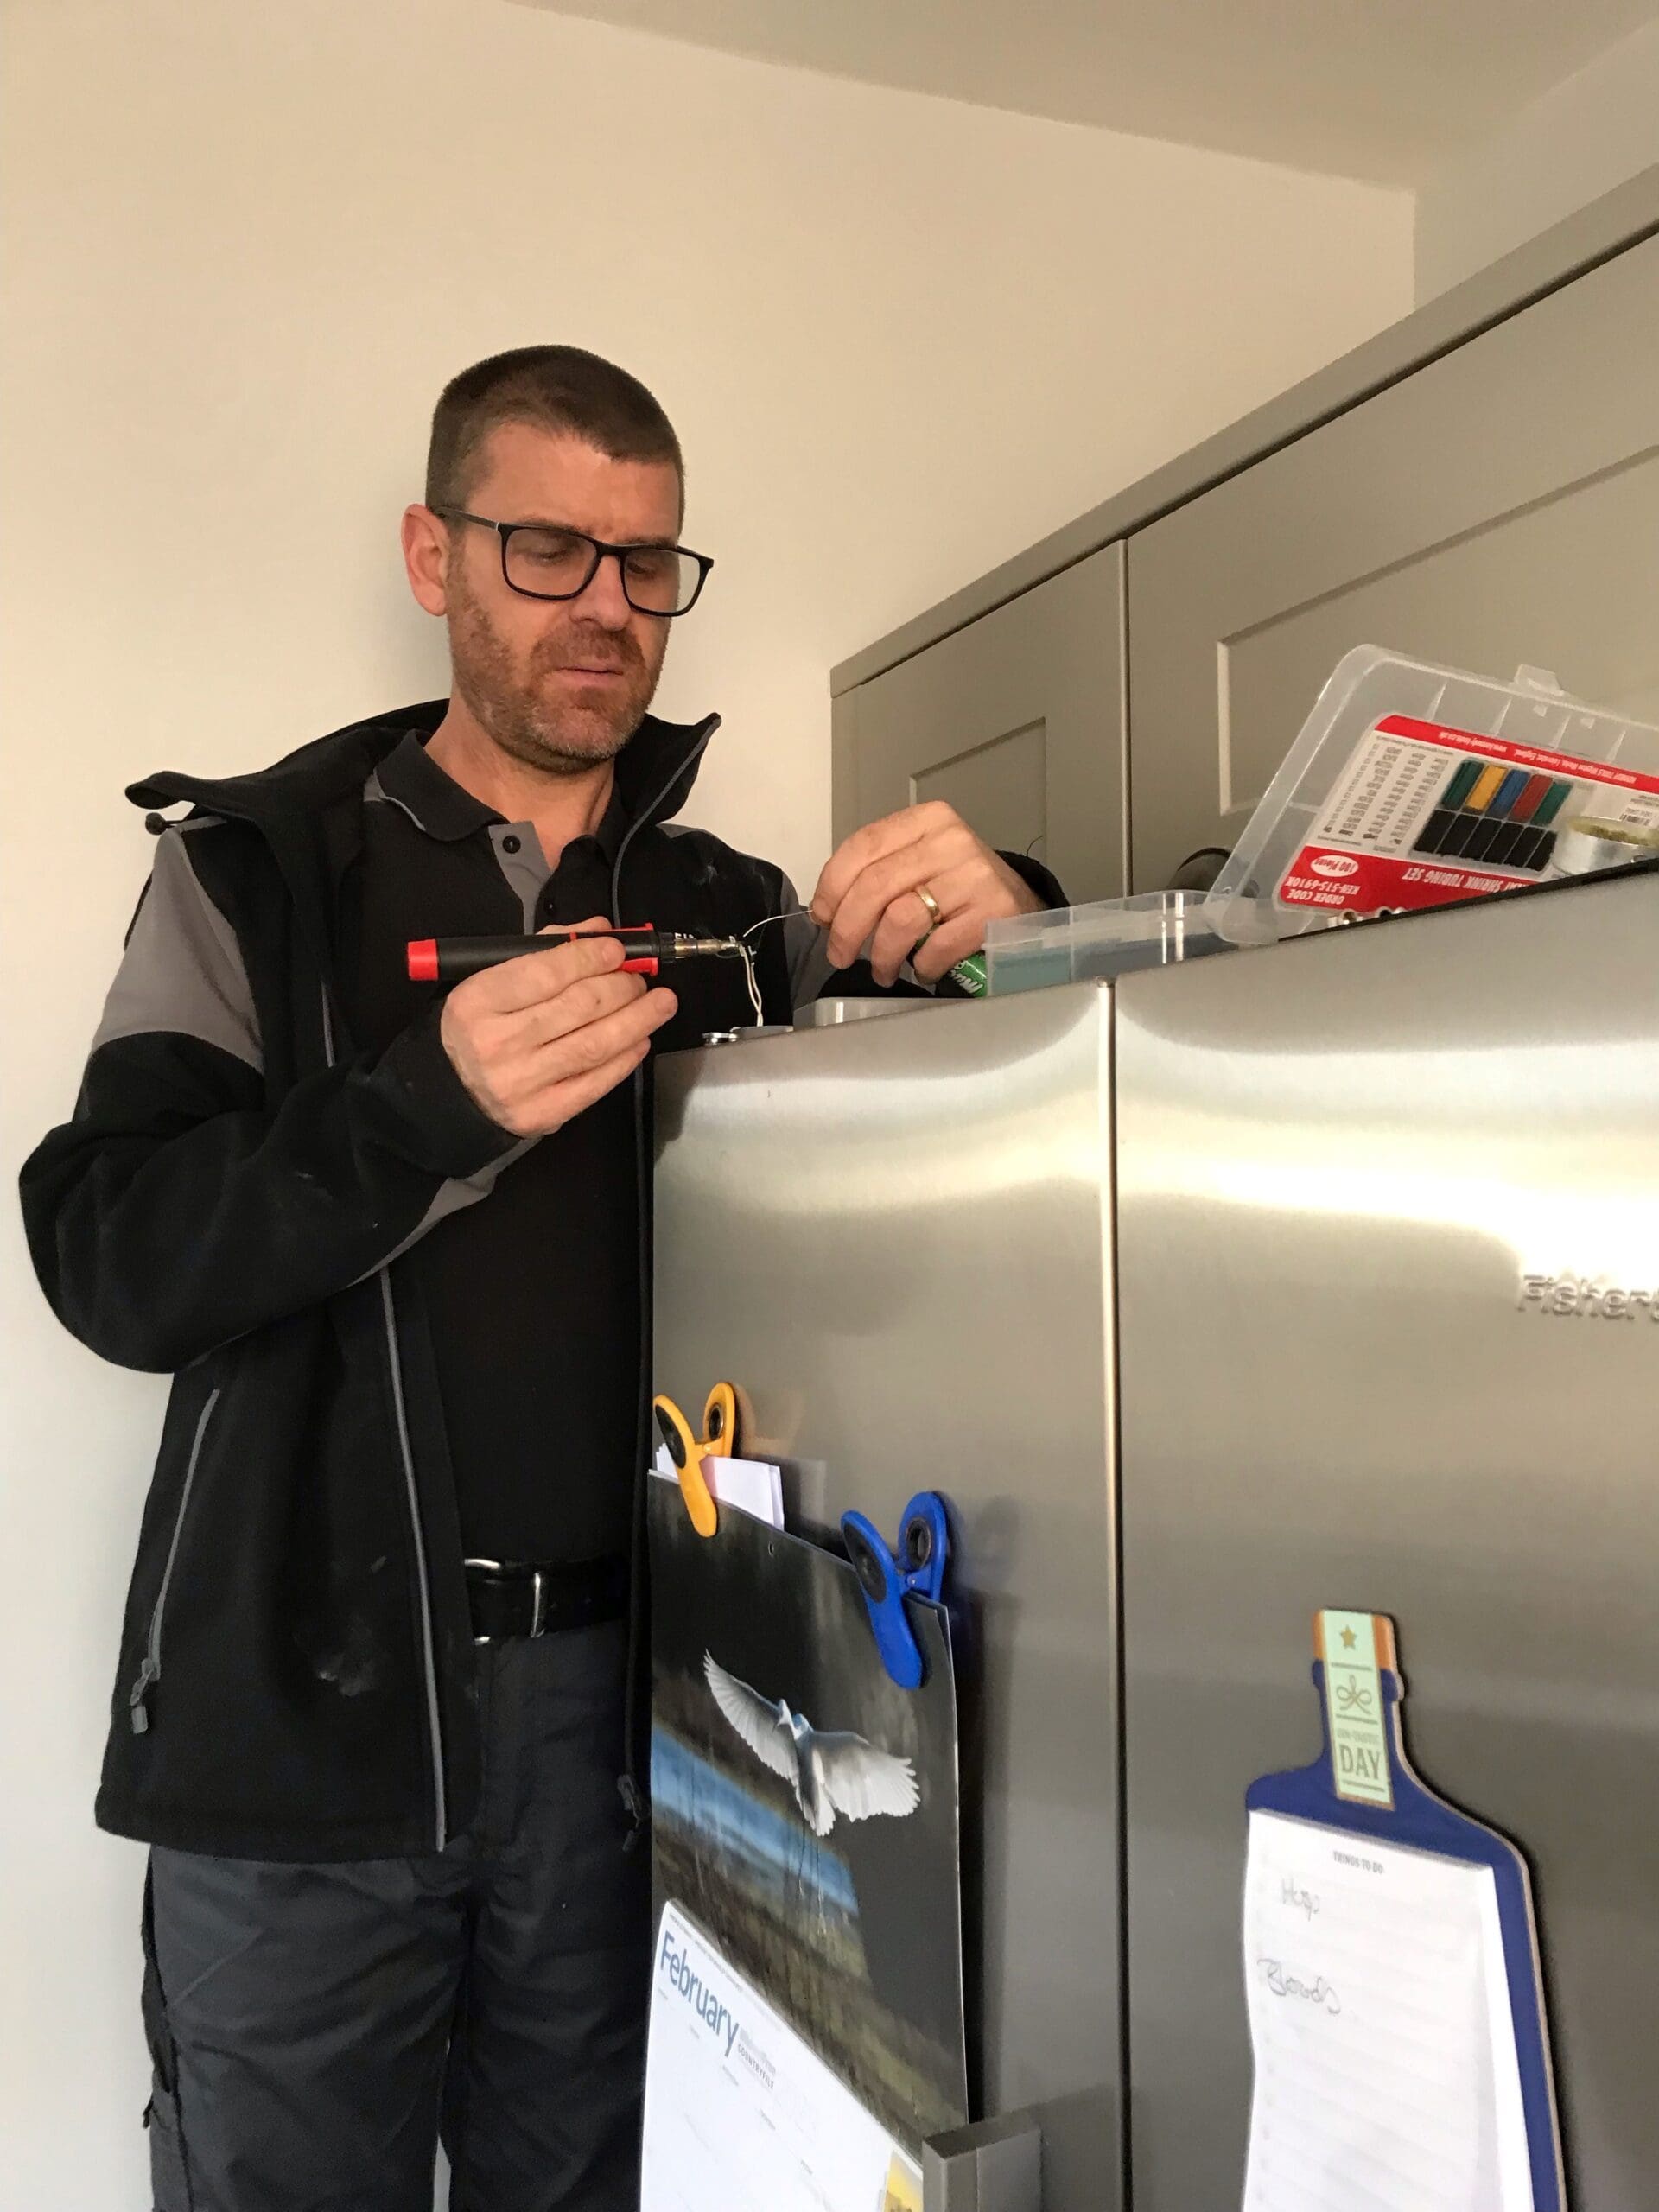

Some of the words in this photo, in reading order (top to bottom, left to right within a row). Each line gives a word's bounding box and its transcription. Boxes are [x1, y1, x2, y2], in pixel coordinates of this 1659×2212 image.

[1402, 867, 1426, 881] SET
[1423, 869, 1465, 887] TUBING
[1463, 875, 1504, 893] SHRINK
[1287, 888, 1313, 901] CODE
[1313, 892, 1345, 905] ORDER
[1338, 1744, 1381, 1780] DAY
[1333, 1851, 1360, 1868] THINGS
[1361, 1859, 1372, 1871] TO
[1372, 1861, 1384, 1874] DO
[660, 1930, 741, 2057] February
